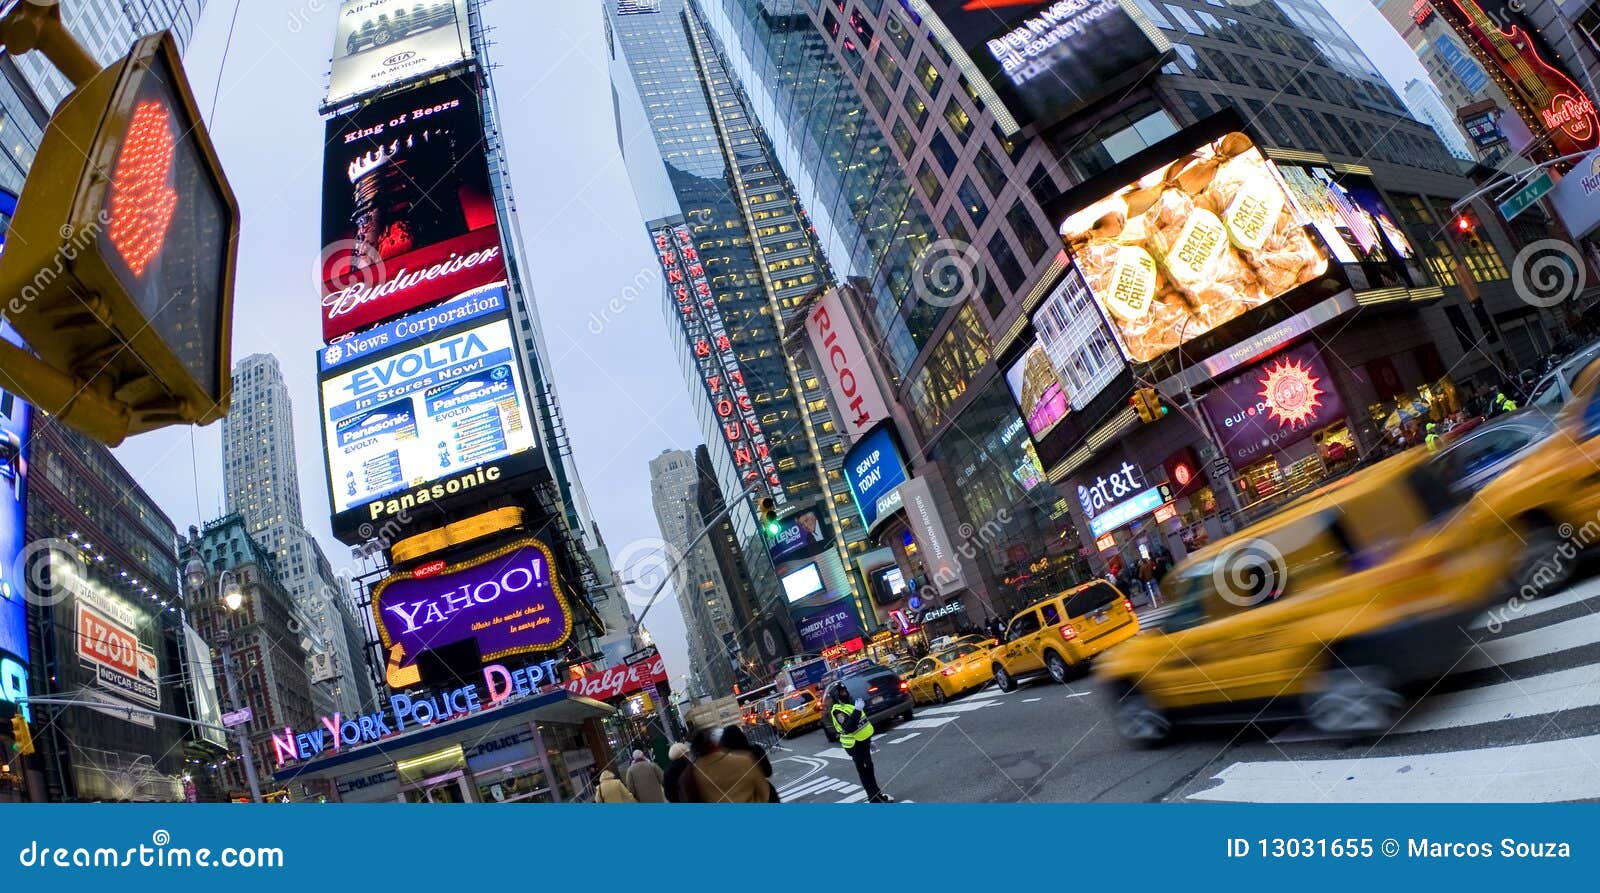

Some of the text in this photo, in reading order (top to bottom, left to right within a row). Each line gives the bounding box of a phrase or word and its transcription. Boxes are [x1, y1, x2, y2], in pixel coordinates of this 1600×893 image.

[389, 58, 427, 73] MOTORS
[344, 98, 460, 144] King of Beers
[1515, 187, 1538, 206] 7 Av
[1582, 172, 1600, 195] Har
[322, 245, 499, 320] Budweiser
[345, 332, 388, 358] News
[395, 294, 500, 338] Corporation
[343, 333, 489, 396] EVOLTA
[813, 306, 871, 428] RICOH
[355, 398, 371, 410] In
[376, 375, 433, 401] Stores
[438, 359, 484, 382] Now!
[432, 380, 509, 412] Panasonic
[343, 412, 410, 444] Panasonic
[435, 406, 472, 423] EVOLTA
[344, 437, 379, 455] EVOLTA
[856, 449, 880, 477] SIGN UP
[369, 464, 501, 520] Panasonic
[858, 465, 881, 494] TODAY
[1090, 461, 1141, 509] at&t
[776, 525, 800, 544] LENO
[414, 562, 444, 577] VACANCY
[386, 558, 543, 634] YAHOO!
[925, 601, 960, 621] CHASE
[471, 619, 491, 631] Where
[492, 616, 503, 625] the
[504, 608, 523, 621] world
[519, 621, 536, 633] every
[85, 617, 134, 667] IZOD
[100, 667, 157, 698] INDYCAR SERIES
[568, 659, 665, 697] Walgre
[272, 659, 557, 765] NEW YORK POLICE DEPT
[479, 733, 520, 754] POLICE
[350, 772, 385, 790] POLICE
